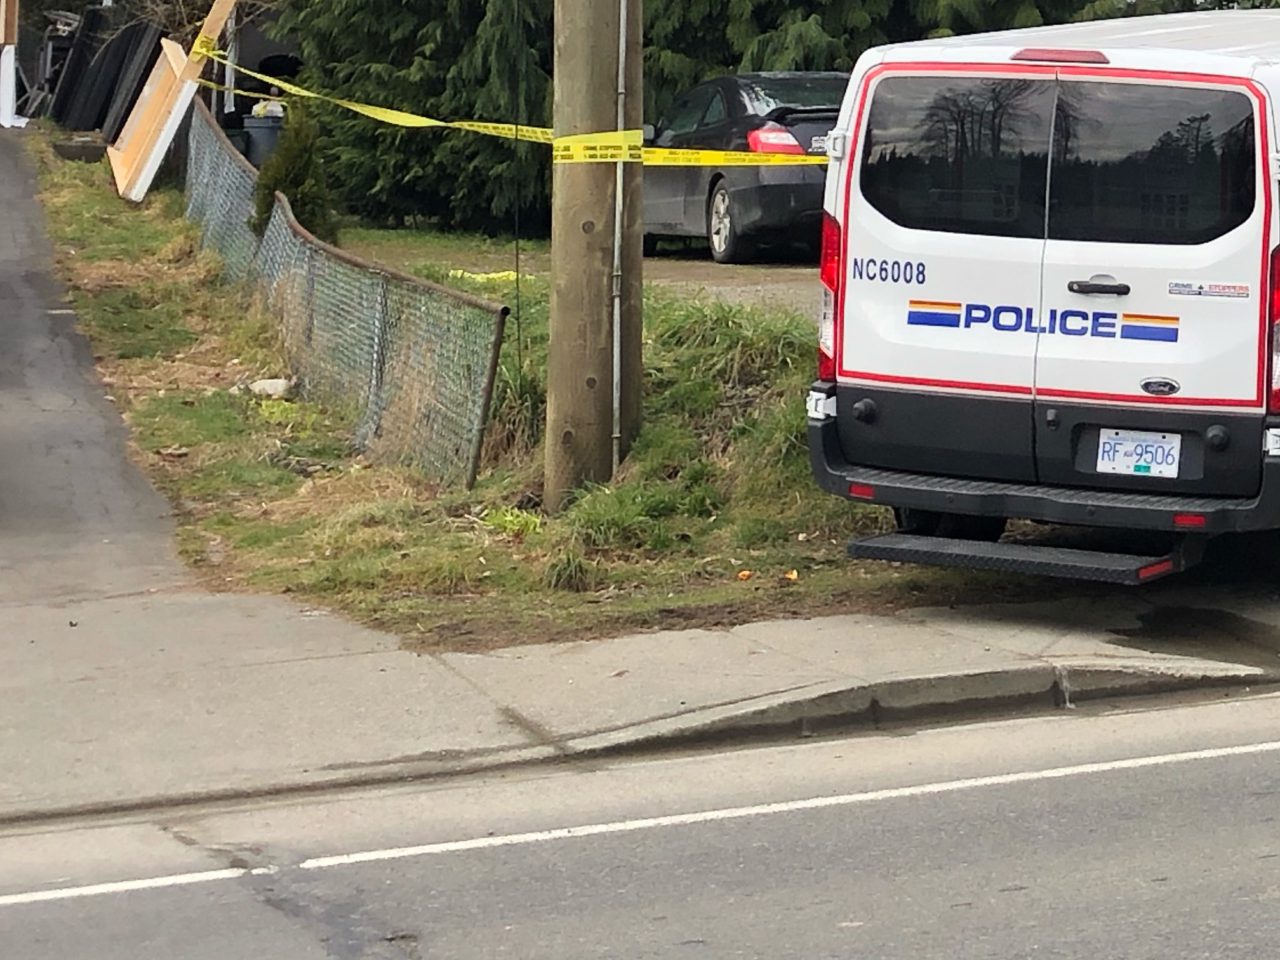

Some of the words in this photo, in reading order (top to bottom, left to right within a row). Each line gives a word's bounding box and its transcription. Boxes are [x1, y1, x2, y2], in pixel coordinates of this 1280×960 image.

[853, 257, 926, 284] NC6008
[964, 303, 1118, 338] POLICE
[1101, 441, 1124, 462] RF
[1134, 443, 1176, 466] 9506
